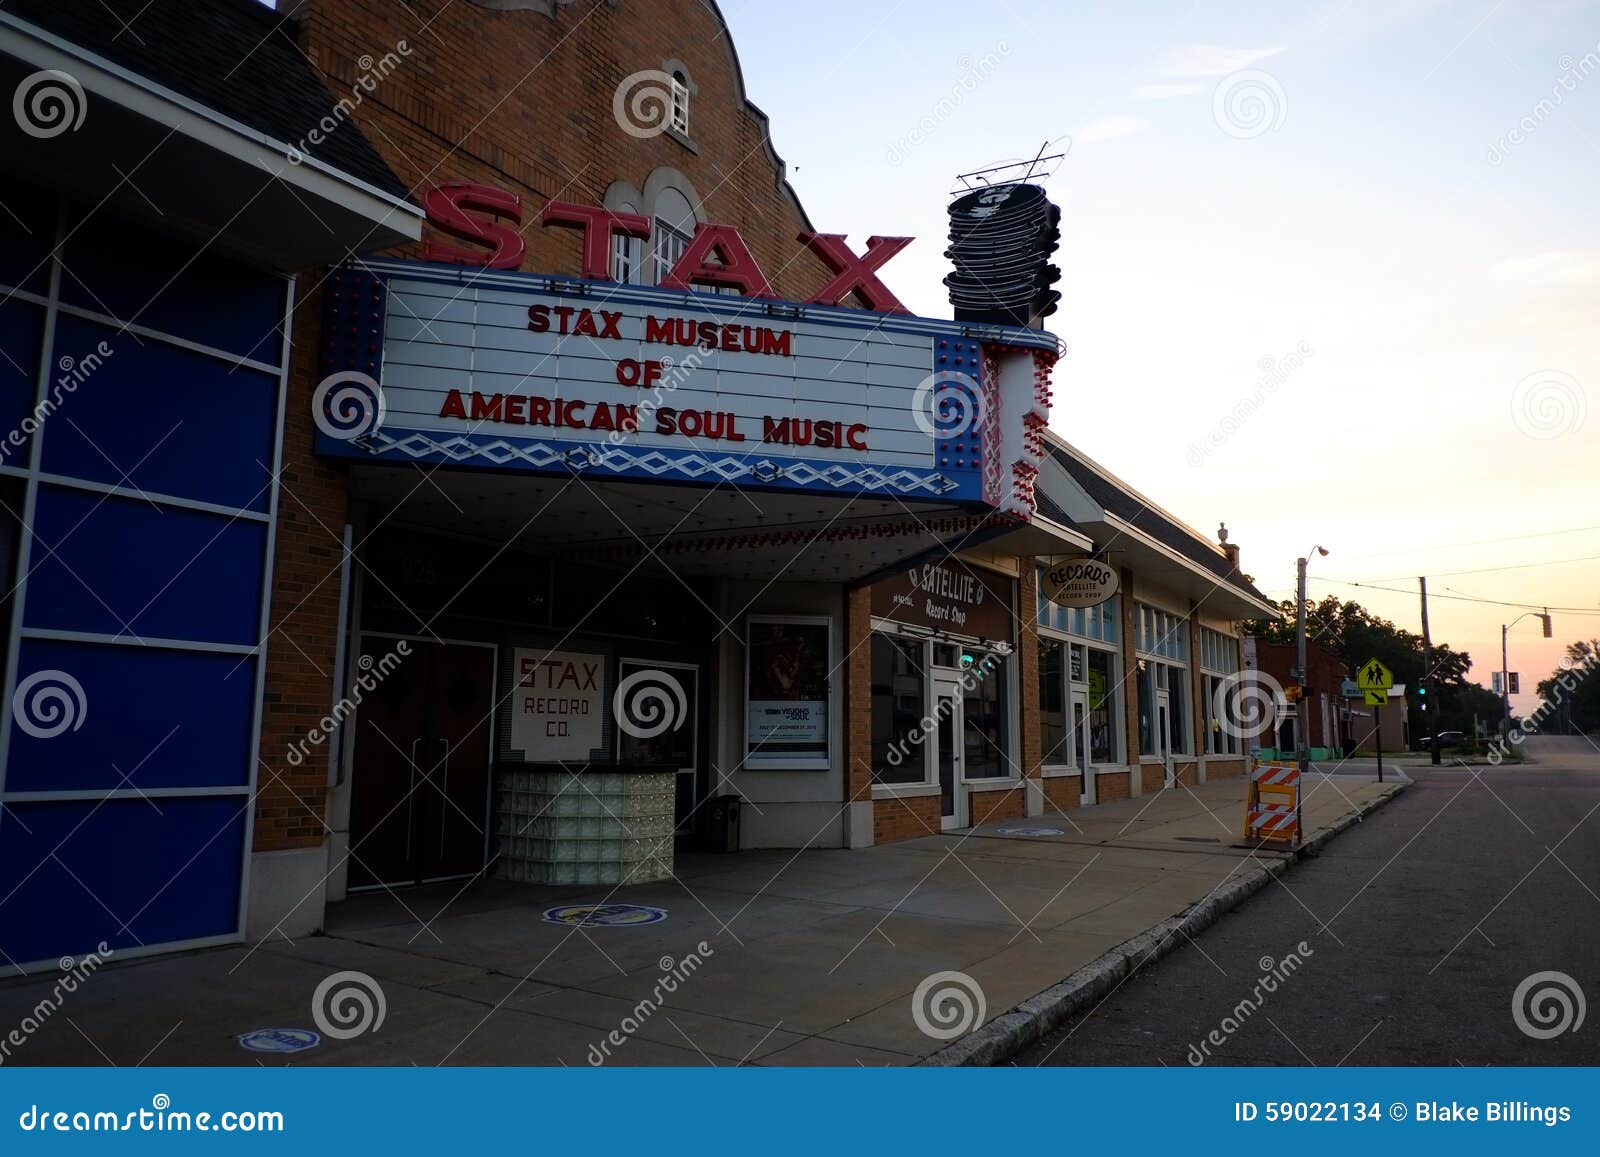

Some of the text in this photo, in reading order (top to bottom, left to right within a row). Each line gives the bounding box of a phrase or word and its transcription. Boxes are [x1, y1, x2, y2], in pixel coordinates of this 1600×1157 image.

[420, 183, 916, 315] STAX
[528, 304, 790, 357] STAX MUSEUM
[616, 358, 663, 388] OF
[440, 390, 869, 451] AMERICAN SOUL MUSIC
[922, 563, 975, 604] SATELLITE
[1049, 565, 1111, 587] RECORDS
[1063, 583, 1097, 591] SATELLITE
[1058, 592, 1082, 600] RECORD
[926, 599, 949, 620] Record
[951, 606, 966, 628] Shop
[519, 658, 598, 691] STAX
[524, 697, 589, 715] RECORD
[546, 721, 571, 737] CO.
